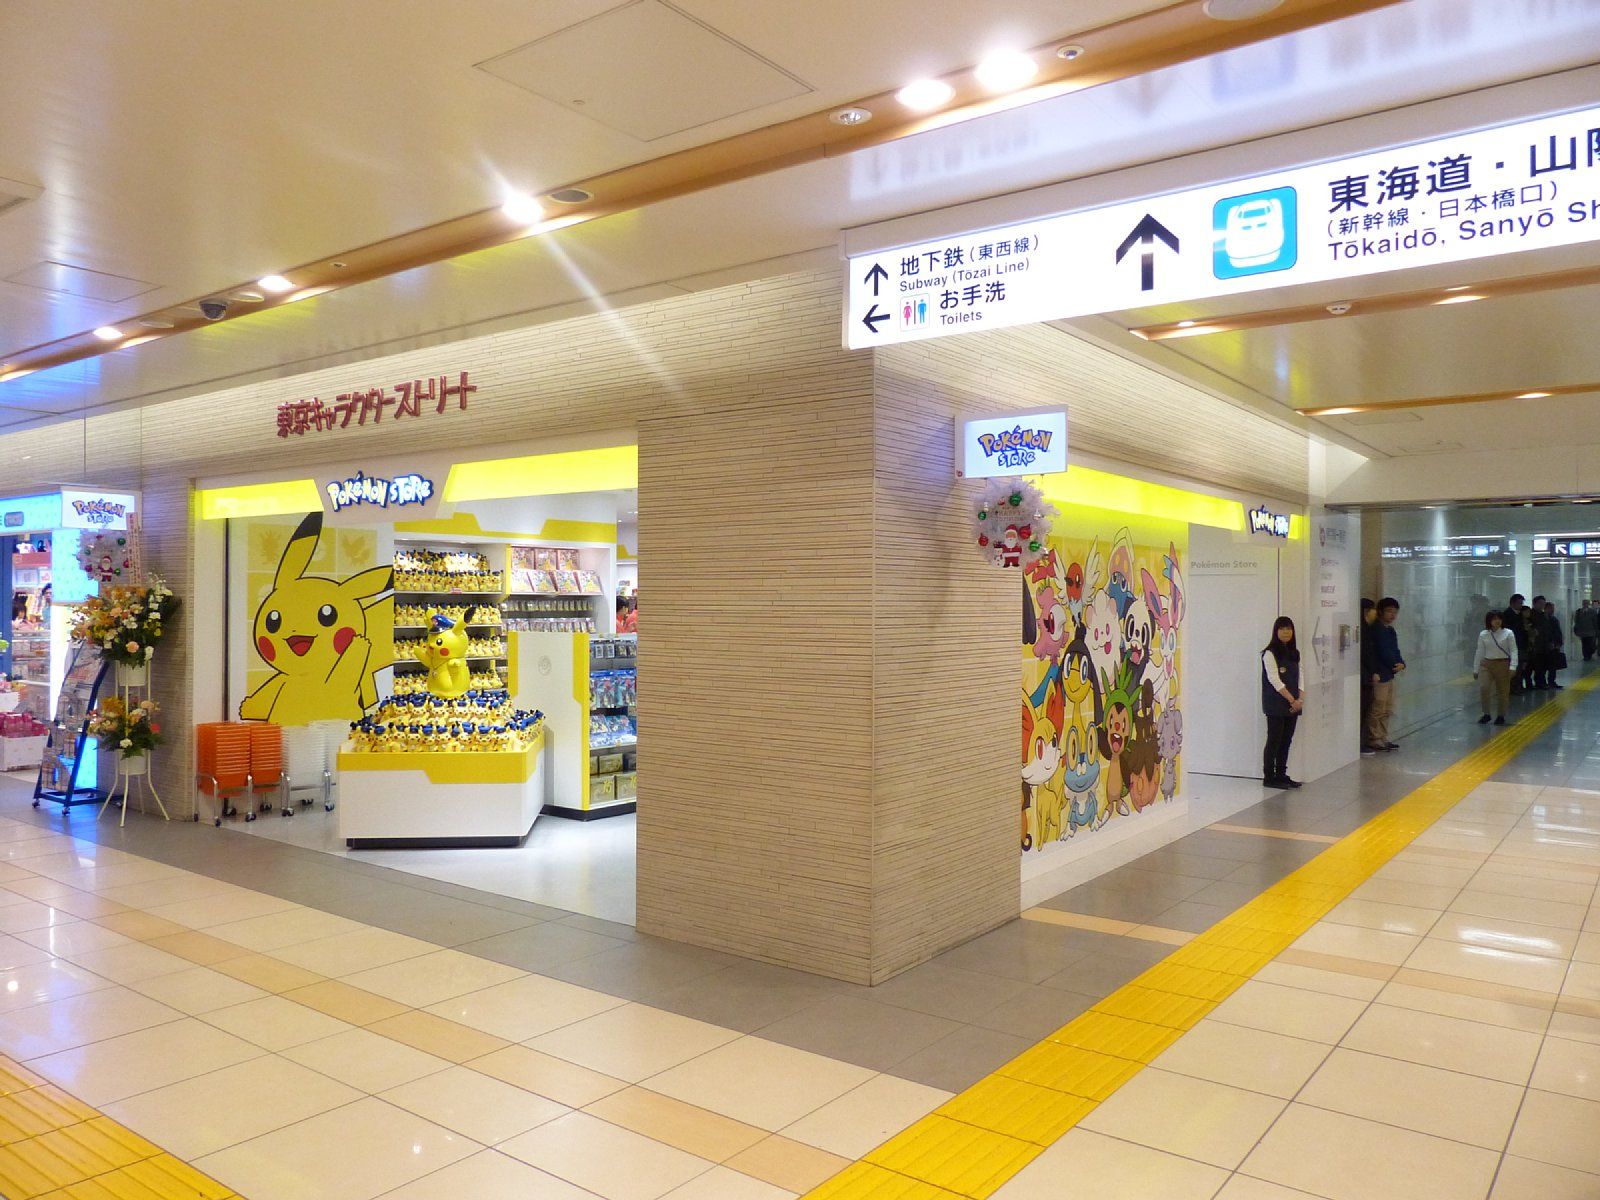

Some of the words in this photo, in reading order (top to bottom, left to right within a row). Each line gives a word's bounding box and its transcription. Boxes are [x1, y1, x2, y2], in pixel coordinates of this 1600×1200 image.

[1459, 207, 1554, 241] Sanyō
[900, 273, 948, 293] Subway
[996, 257, 1030, 276] Line)
[940, 281, 1006, 310] お手洗
[940, 310, 983, 326] Toilets
[277, 371, 477, 438] 東京キャラクターストリート
[1190, 559, 1231, 570] Pokémon
[1233, 560, 1258, 569] Store
